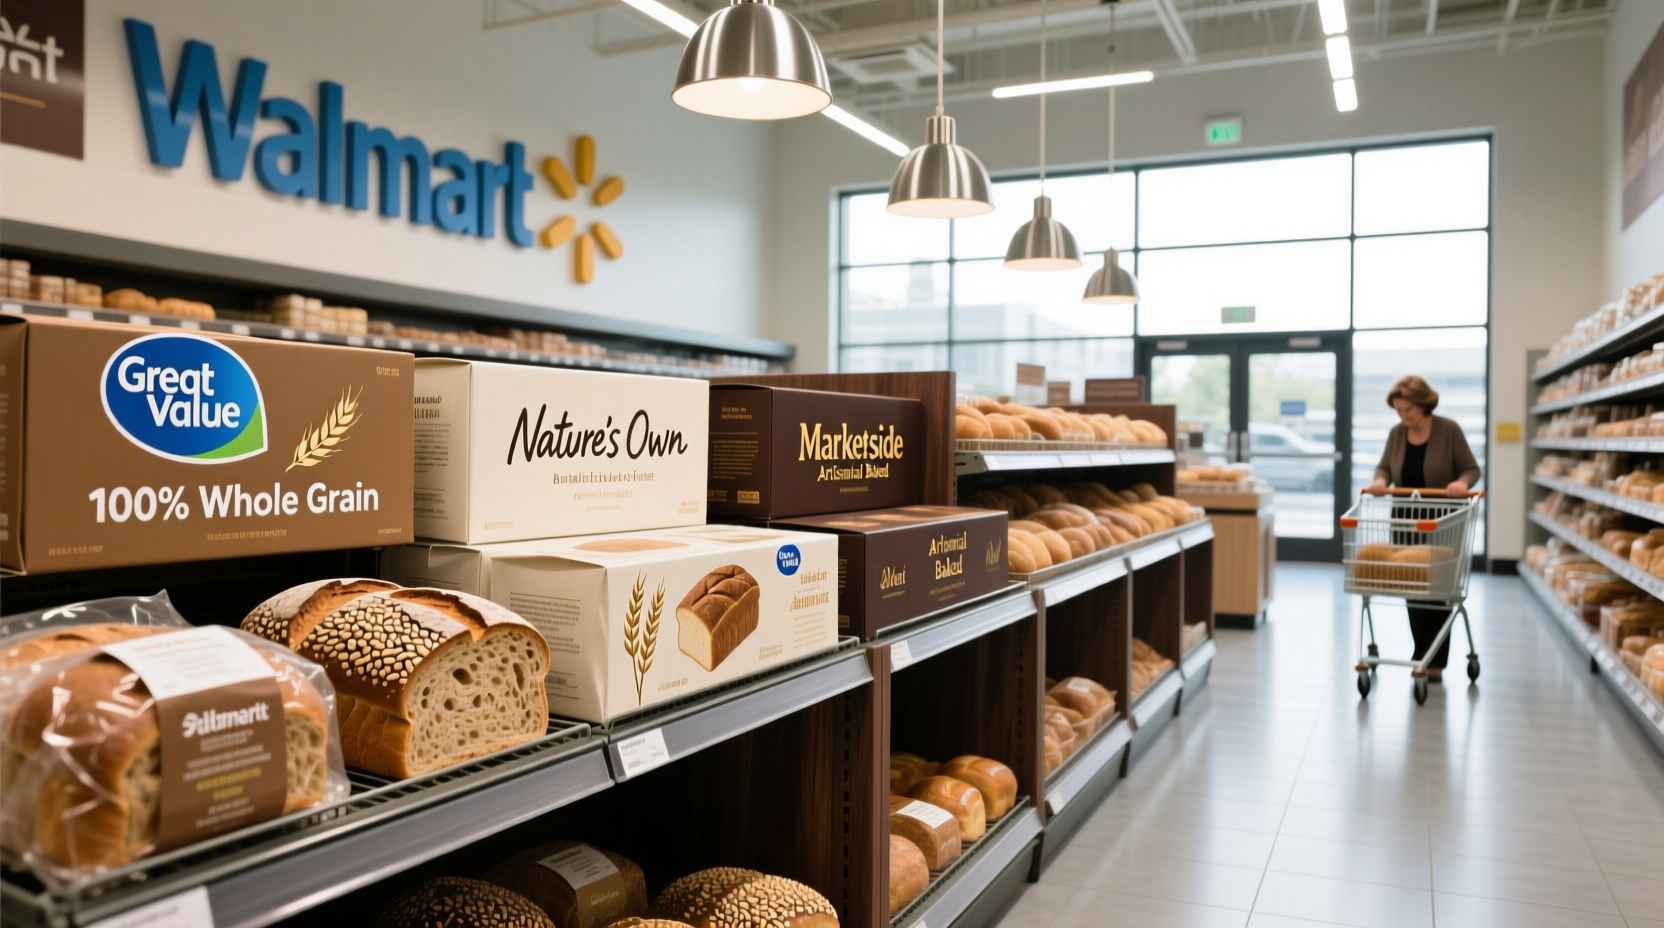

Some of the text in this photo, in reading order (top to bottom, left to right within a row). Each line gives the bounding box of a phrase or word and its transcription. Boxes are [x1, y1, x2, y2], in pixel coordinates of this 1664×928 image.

[124, 17, 533, 248] Walmart
[118, 356, 214, 396] Great
[146, 394, 241, 428] Value
[507, 403, 621, 465] Nature's
[626, 409, 688, 460] Own
[799, 422, 904, 461] Marketside
[88, 486, 189, 523] 100%
[199, 482, 298, 518] Whole
[307, 481, 379, 514] Grain
